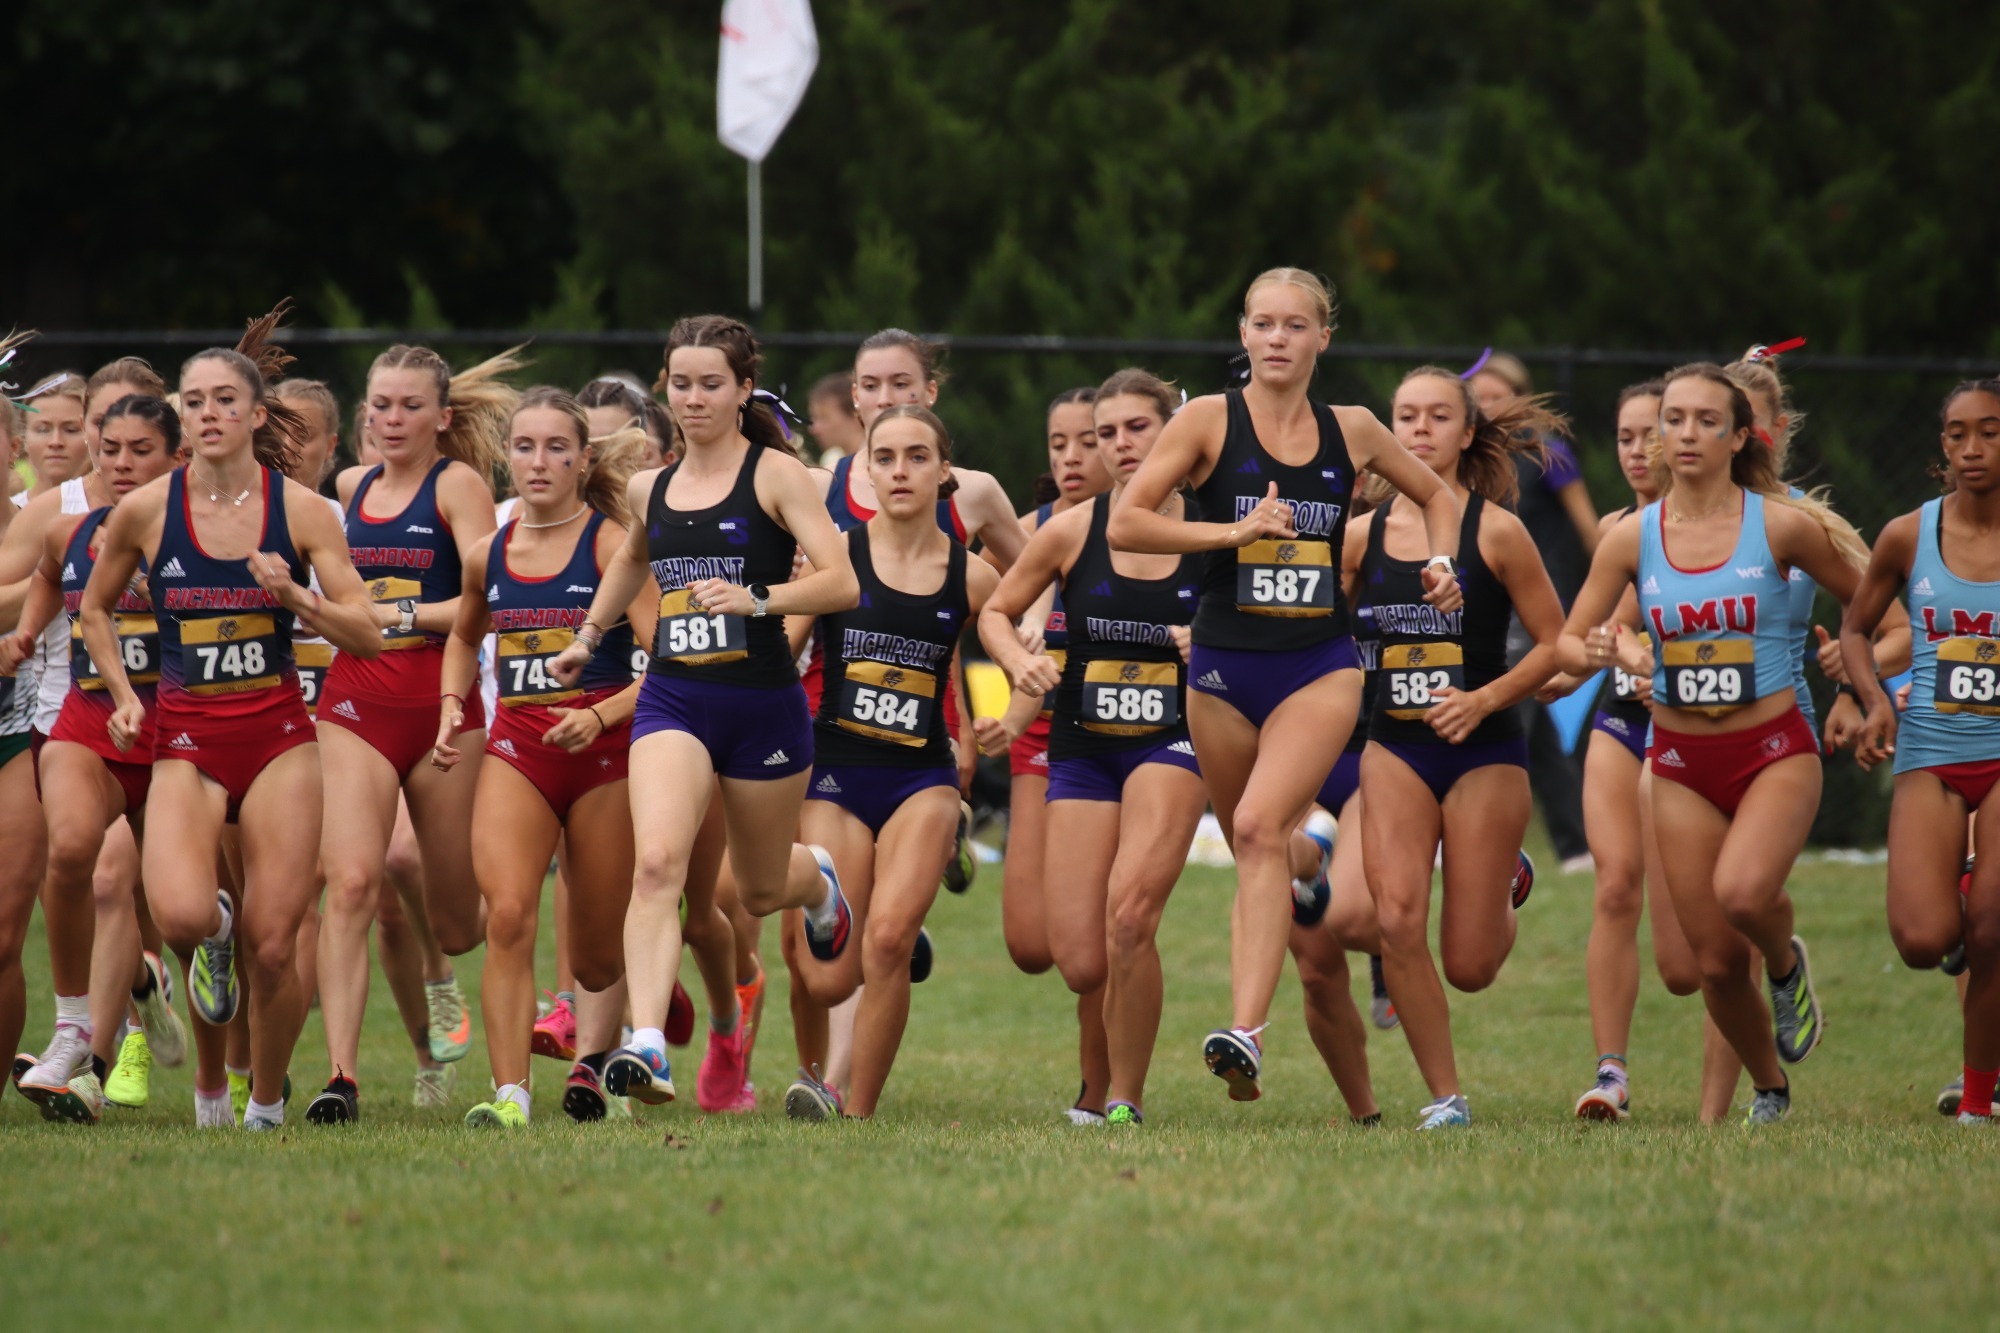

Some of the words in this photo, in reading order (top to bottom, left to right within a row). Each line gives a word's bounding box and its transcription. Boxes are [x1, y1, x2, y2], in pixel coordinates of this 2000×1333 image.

[406, 525, 433, 535] A10
[348, 546, 435, 569] HMOND
[164, 587, 282, 610] RICHMON
[565, 584, 594, 593] A10
[1252, 569, 1321, 603] 587
[669, 614, 727, 653] 581
[1650, 593, 1758, 642] LMU
[1921, 606, 2000, 645] LM
[197, 641, 266, 681] 748
[1391, 670, 1450, 705] 582
[1677, 667, 1742, 703] 629
[1949, 666, 2000, 701] 63
[853, 687, 920, 731] 584
[1096, 687, 1164, 722] 586
